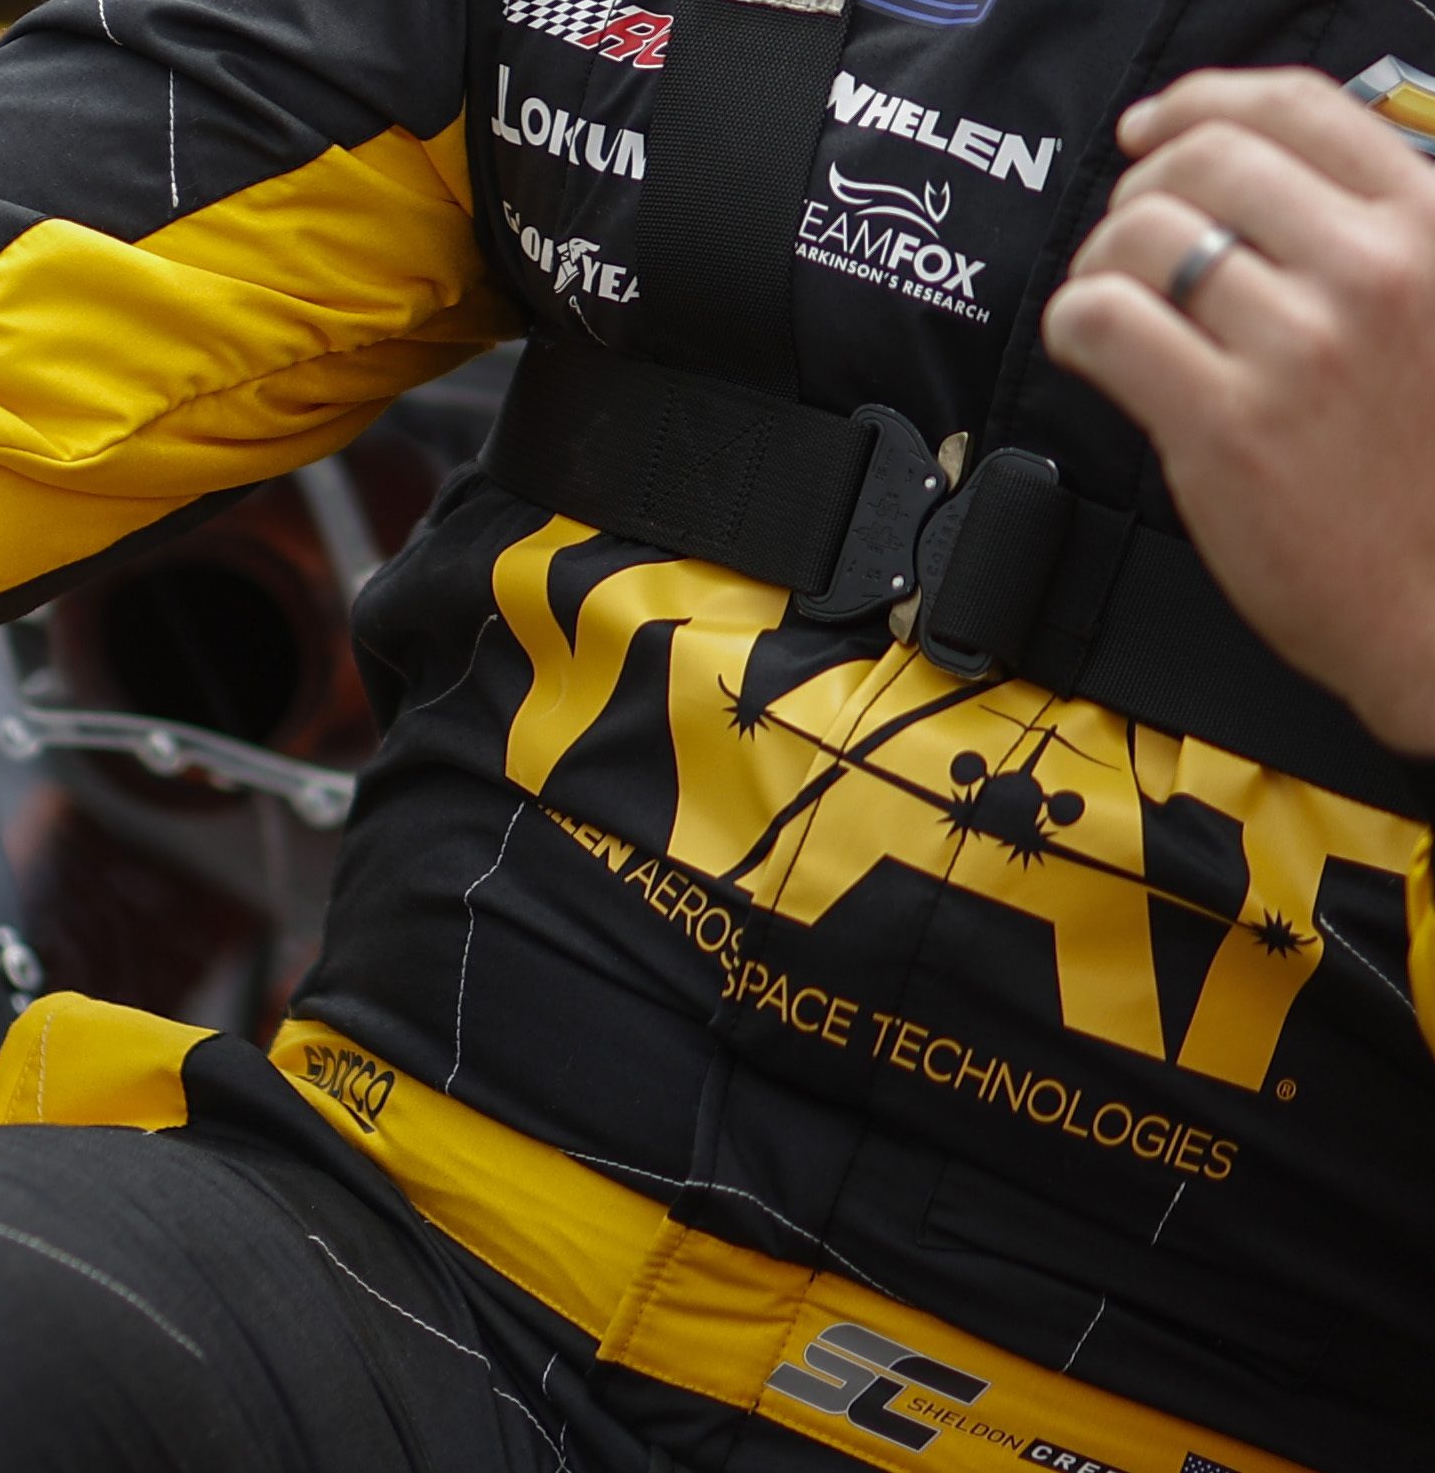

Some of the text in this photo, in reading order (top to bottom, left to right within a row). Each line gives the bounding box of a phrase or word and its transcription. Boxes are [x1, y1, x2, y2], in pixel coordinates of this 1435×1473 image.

[827, 70, 1057, 193] WHELEN
[794, 242, 991, 325] ARKINSON'S RESEARCH
[797, 199, 987, 300] EAMFOX
[623, 857, 860, 1046] AEROSPACE
[872, 1011, 1240, 1181] TECHNOLOGIES
[907, 1396, 1120, 1473] SHELDON CRE
